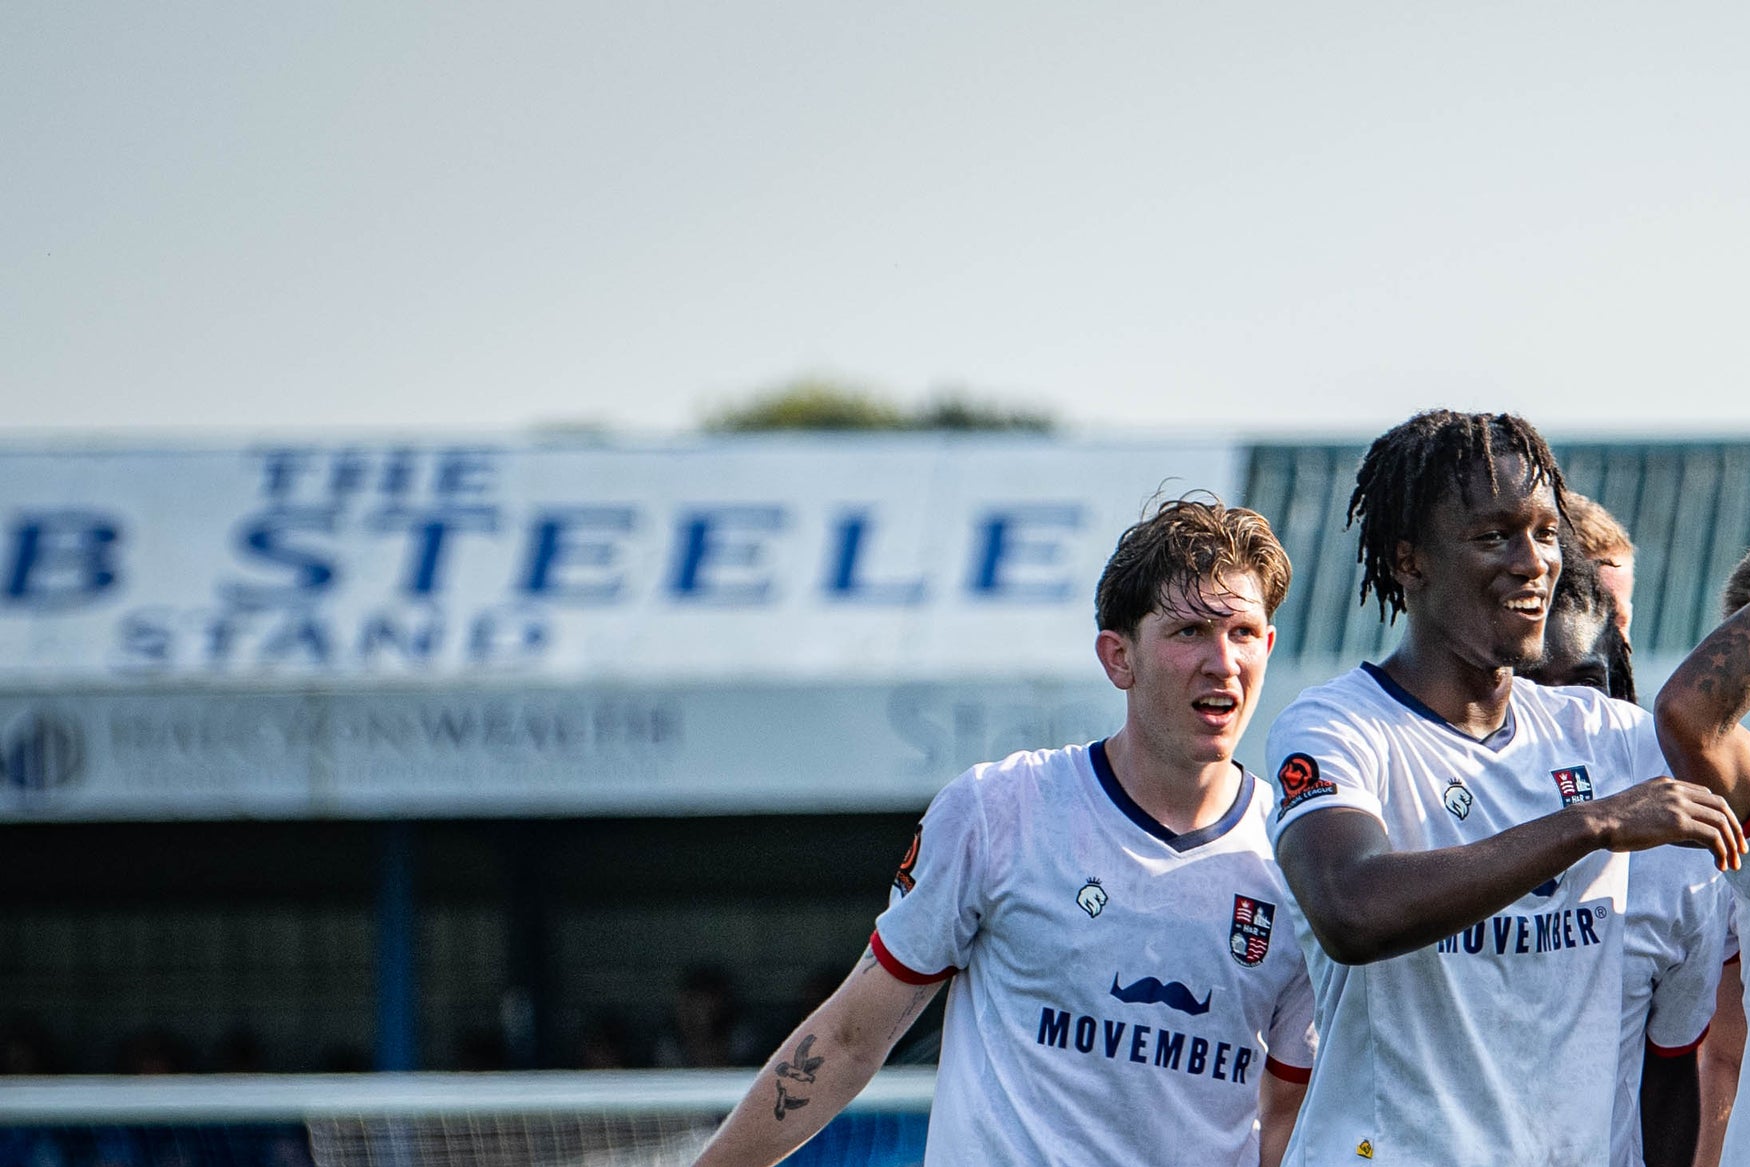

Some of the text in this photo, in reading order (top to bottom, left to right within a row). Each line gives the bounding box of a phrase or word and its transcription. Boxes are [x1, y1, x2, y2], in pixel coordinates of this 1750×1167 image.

[255, 449, 499, 497] THE
[222, 503, 1090, 604] STEELE
[117, 609, 548, 662] STAND
[1037, 1007, 1252, 1085] MOVEMBER
